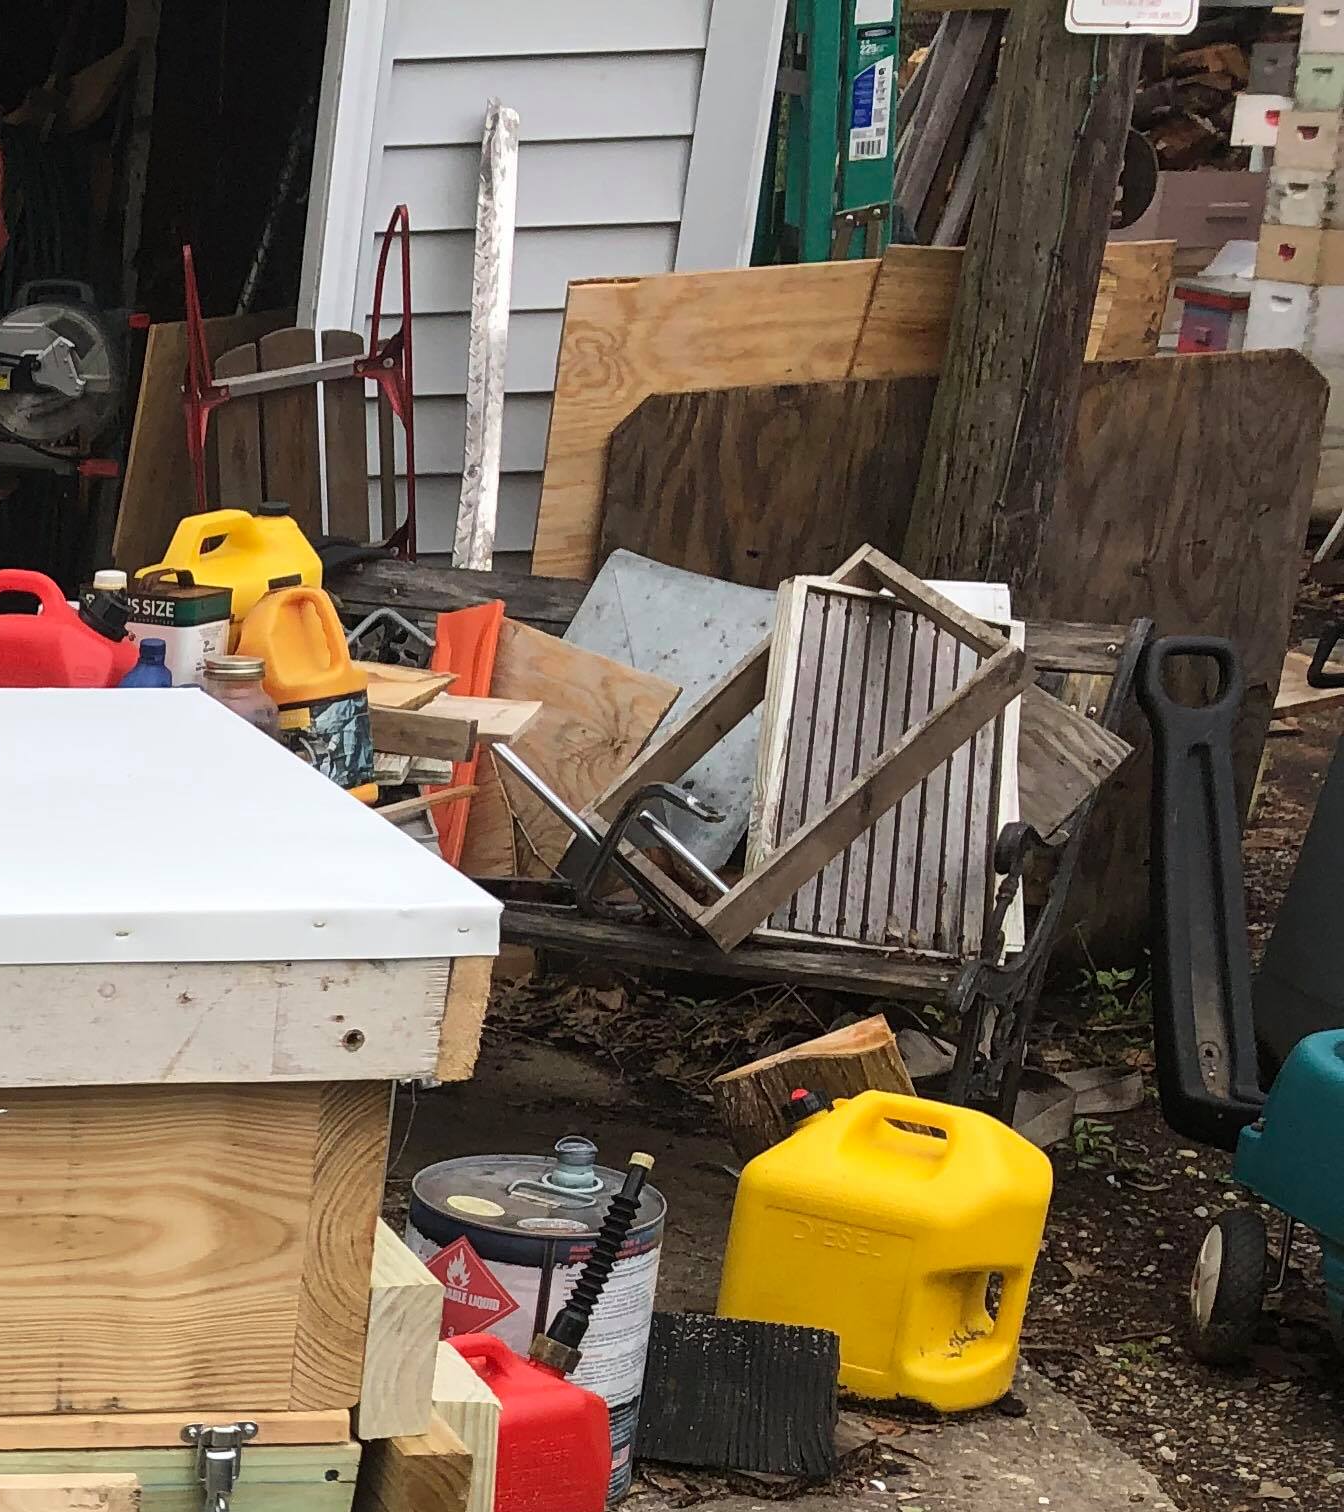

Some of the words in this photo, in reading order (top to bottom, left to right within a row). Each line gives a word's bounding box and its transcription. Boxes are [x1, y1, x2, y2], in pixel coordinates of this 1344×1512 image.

[141, 600, 176, 618] SIZE
[792, 1218, 883, 1258] DESEL
[468, 1293, 501, 1312] LIQUID
